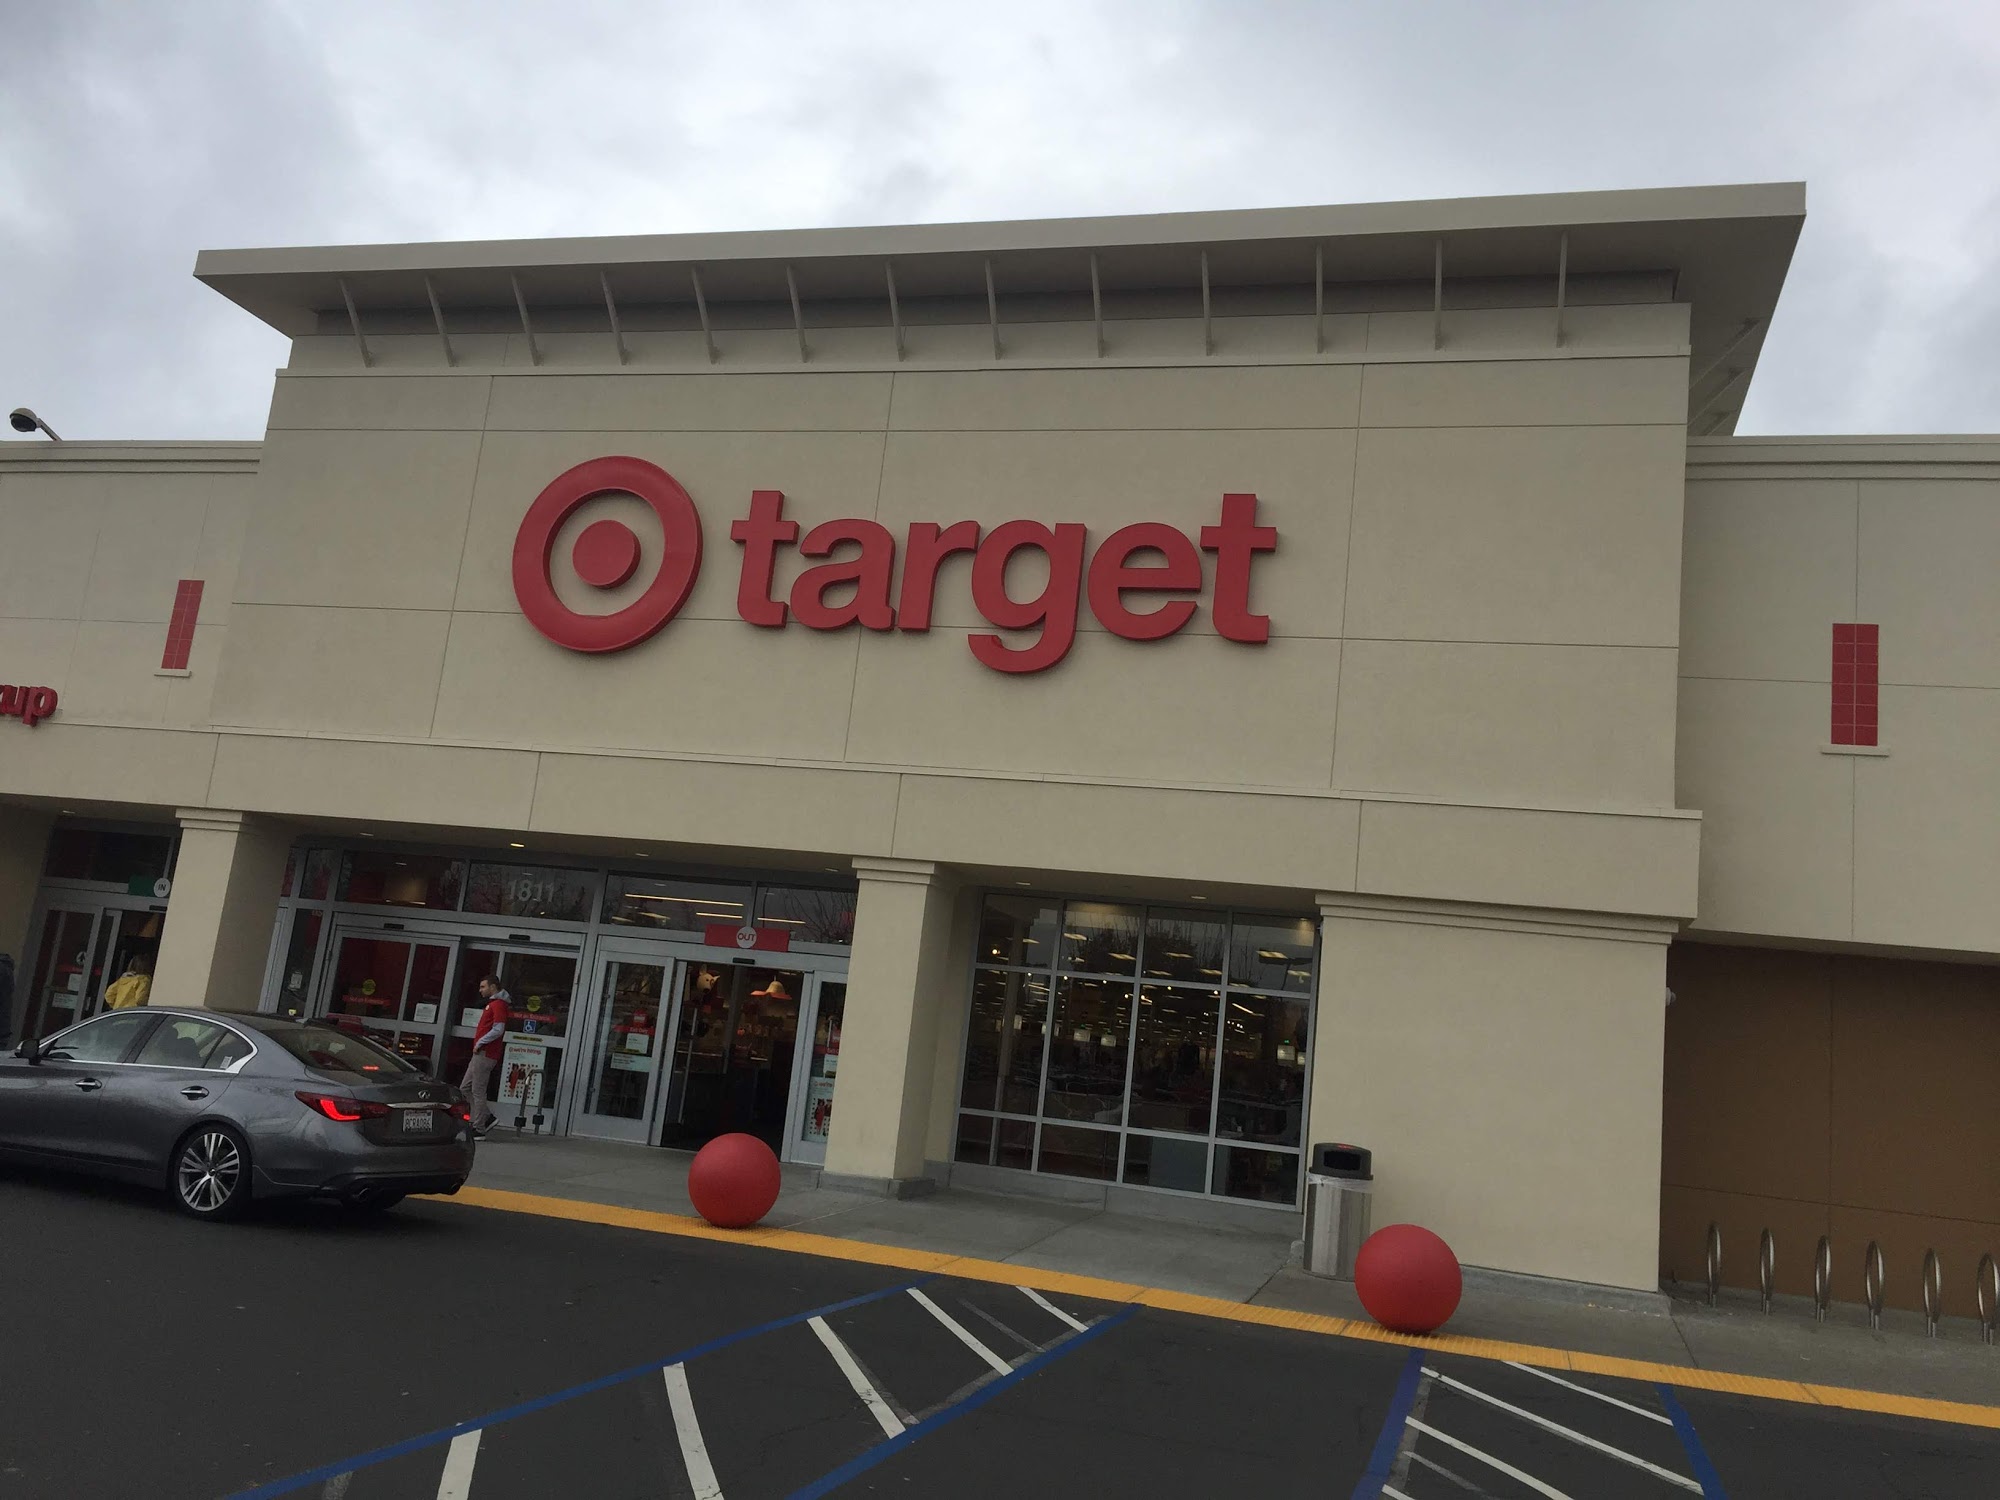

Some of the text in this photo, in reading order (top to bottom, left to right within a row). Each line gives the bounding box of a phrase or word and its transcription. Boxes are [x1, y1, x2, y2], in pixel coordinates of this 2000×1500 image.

[730, 490, 1277, 674] target
[0, 684, 58, 726] up
[157, 884, 166, 892] IN
[508, 880, 554, 904] 1811
[737, 932, 755, 942] OUT
